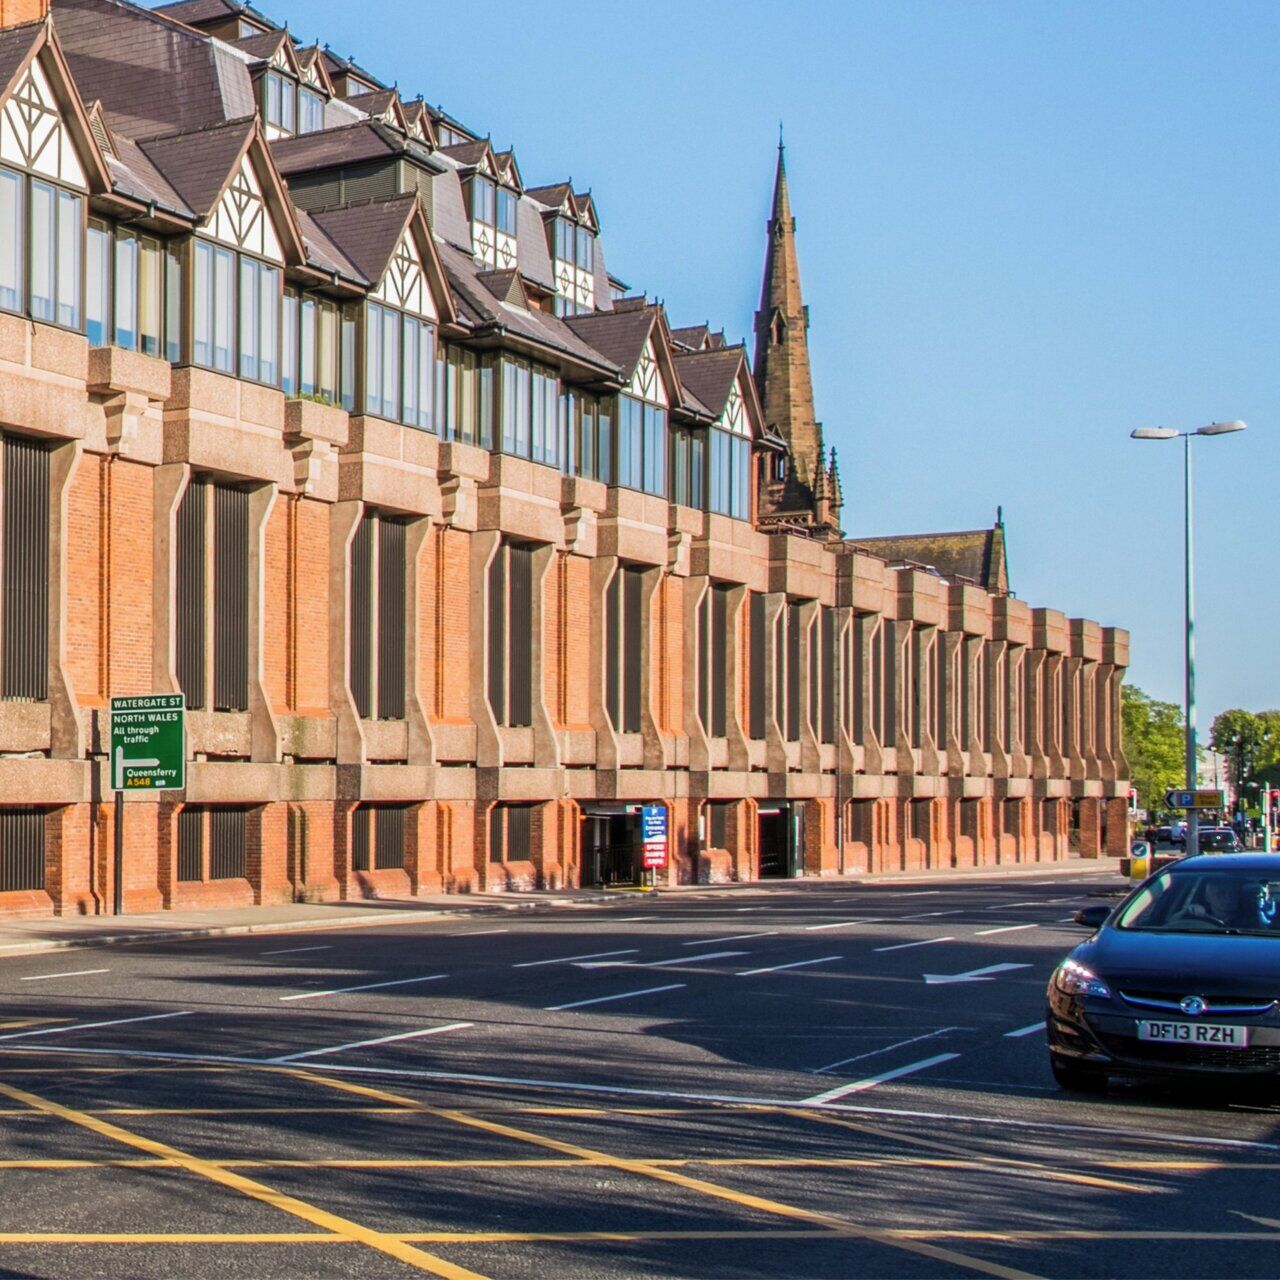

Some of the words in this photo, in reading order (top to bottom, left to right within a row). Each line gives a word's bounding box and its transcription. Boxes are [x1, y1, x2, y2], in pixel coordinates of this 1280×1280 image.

[113, 699, 167, 708] WATERGATE
[169, 697, 181, 706] ST
[113, 714, 145, 723] NORTH
[148, 713, 178, 722] WALES
[113, 727, 125, 735] All
[127, 725, 160, 735] through
[123, 735, 149, 743] traffic
[126, 768, 177, 777] Queensferry
[127, 778, 151, 786] A548
[1182, 794, 1191, 804] P
[1149, 1023, 1190, 1040] DF13
[1196, 1026, 1235, 1043] RZH
